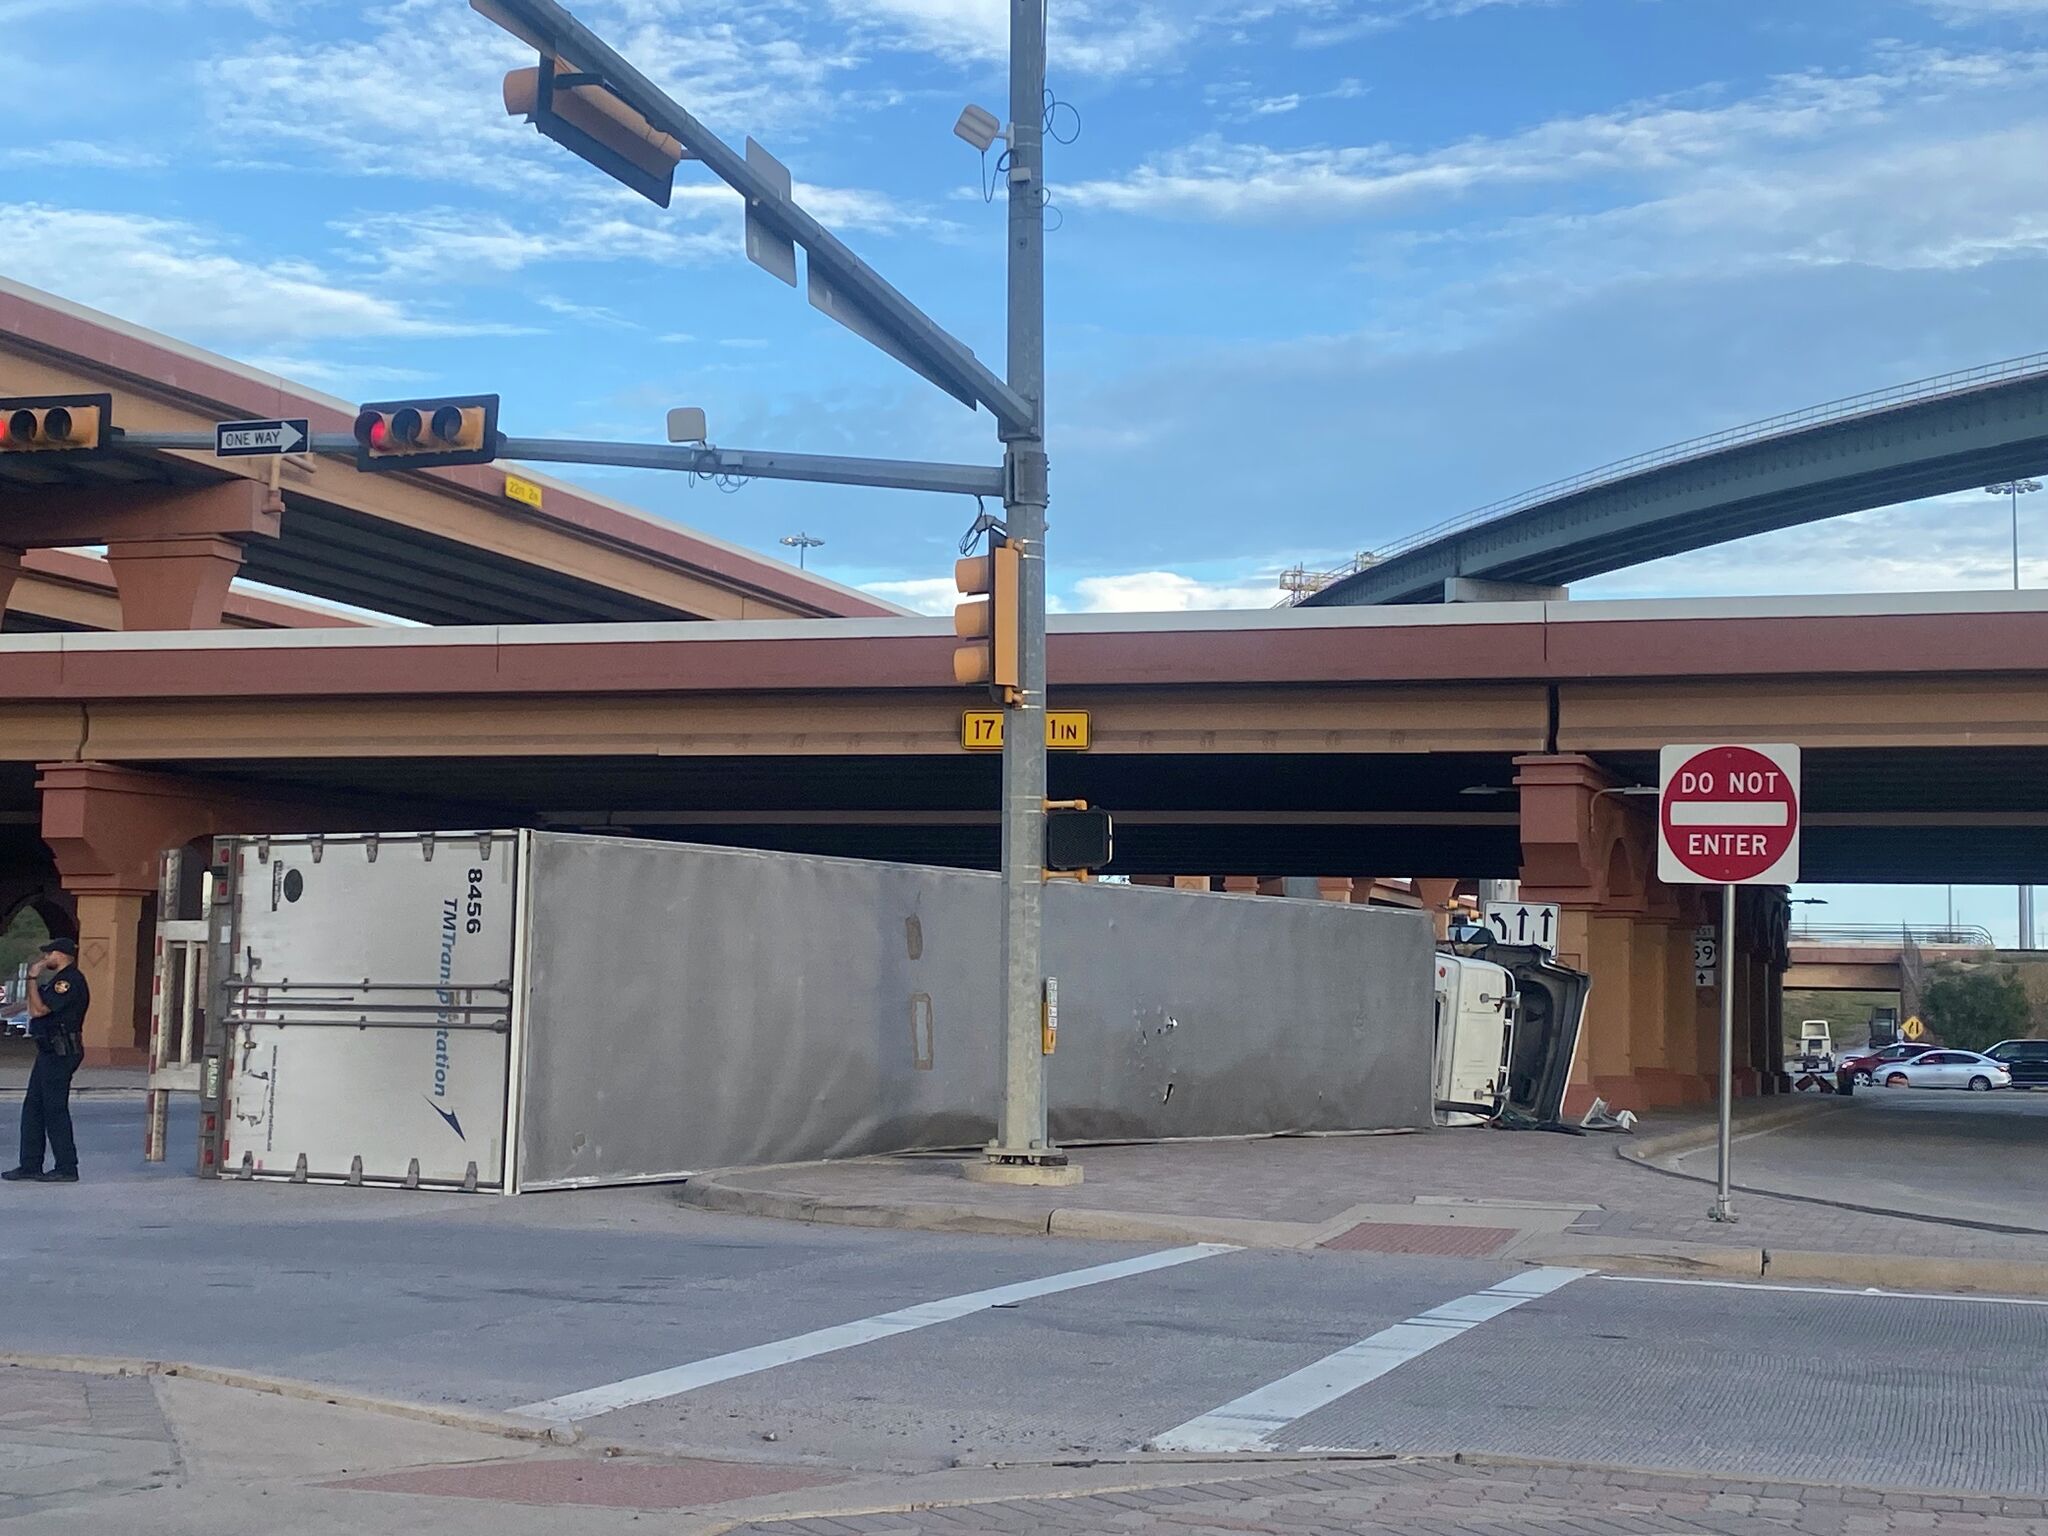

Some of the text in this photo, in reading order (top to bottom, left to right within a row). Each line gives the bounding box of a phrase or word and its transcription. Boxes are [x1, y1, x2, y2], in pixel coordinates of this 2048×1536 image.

[226, 431, 280, 446] ONE WAY
[1681, 772, 1779, 794] DO NOT
[1688, 834, 1768, 856] ENTER
[466, 868, 483, 934] 8456
